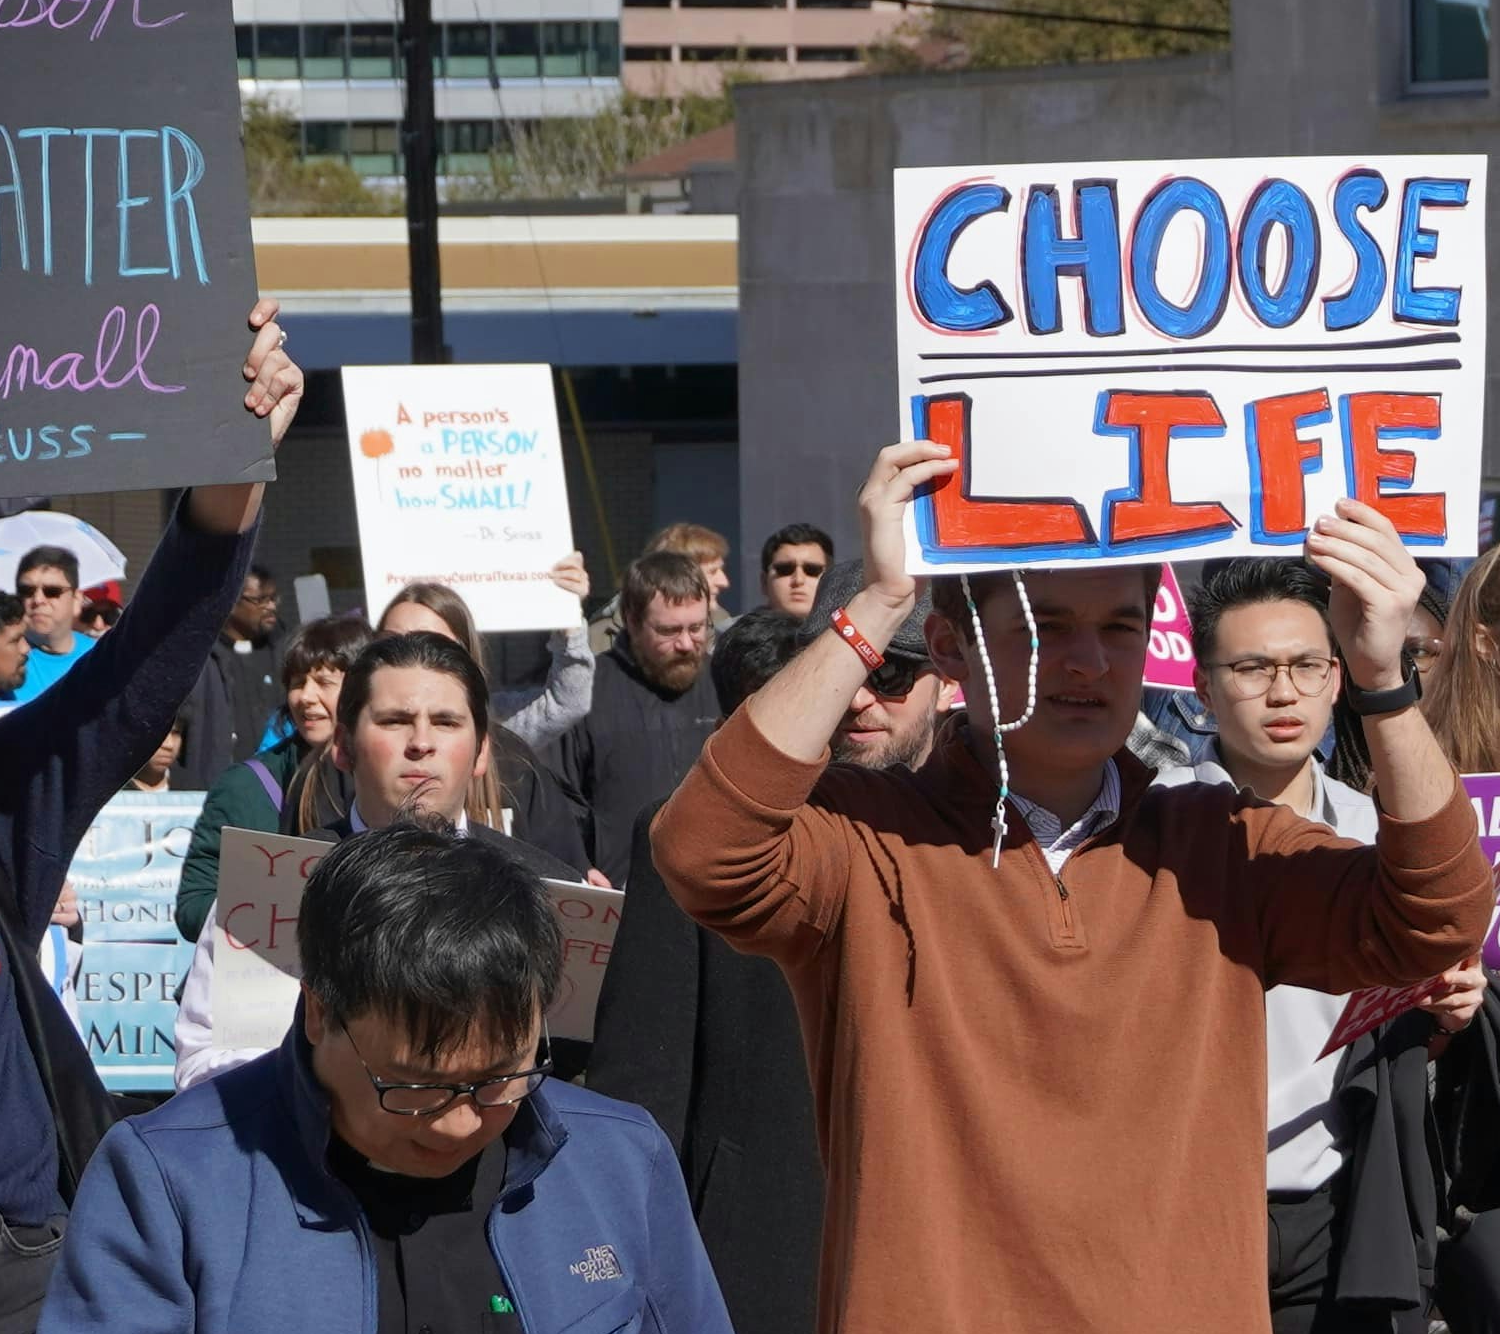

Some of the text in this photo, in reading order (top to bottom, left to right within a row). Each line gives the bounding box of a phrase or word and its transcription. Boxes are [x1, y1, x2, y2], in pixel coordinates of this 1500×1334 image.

[908, 166, 1471, 340] CHOOSE
[397, 402, 509, 427] A person's
[421, 443, 434, 455] a
[399, 458, 508, 480] no matter
[911, 387, 1448, 562] LIFE
[396, 480, 532, 510] how SMALL!
[585, 1245, 609, 1259] THE
[569, 1257, 611, 1275] NORTH
[584, 1268, 614, 1283] FACE
